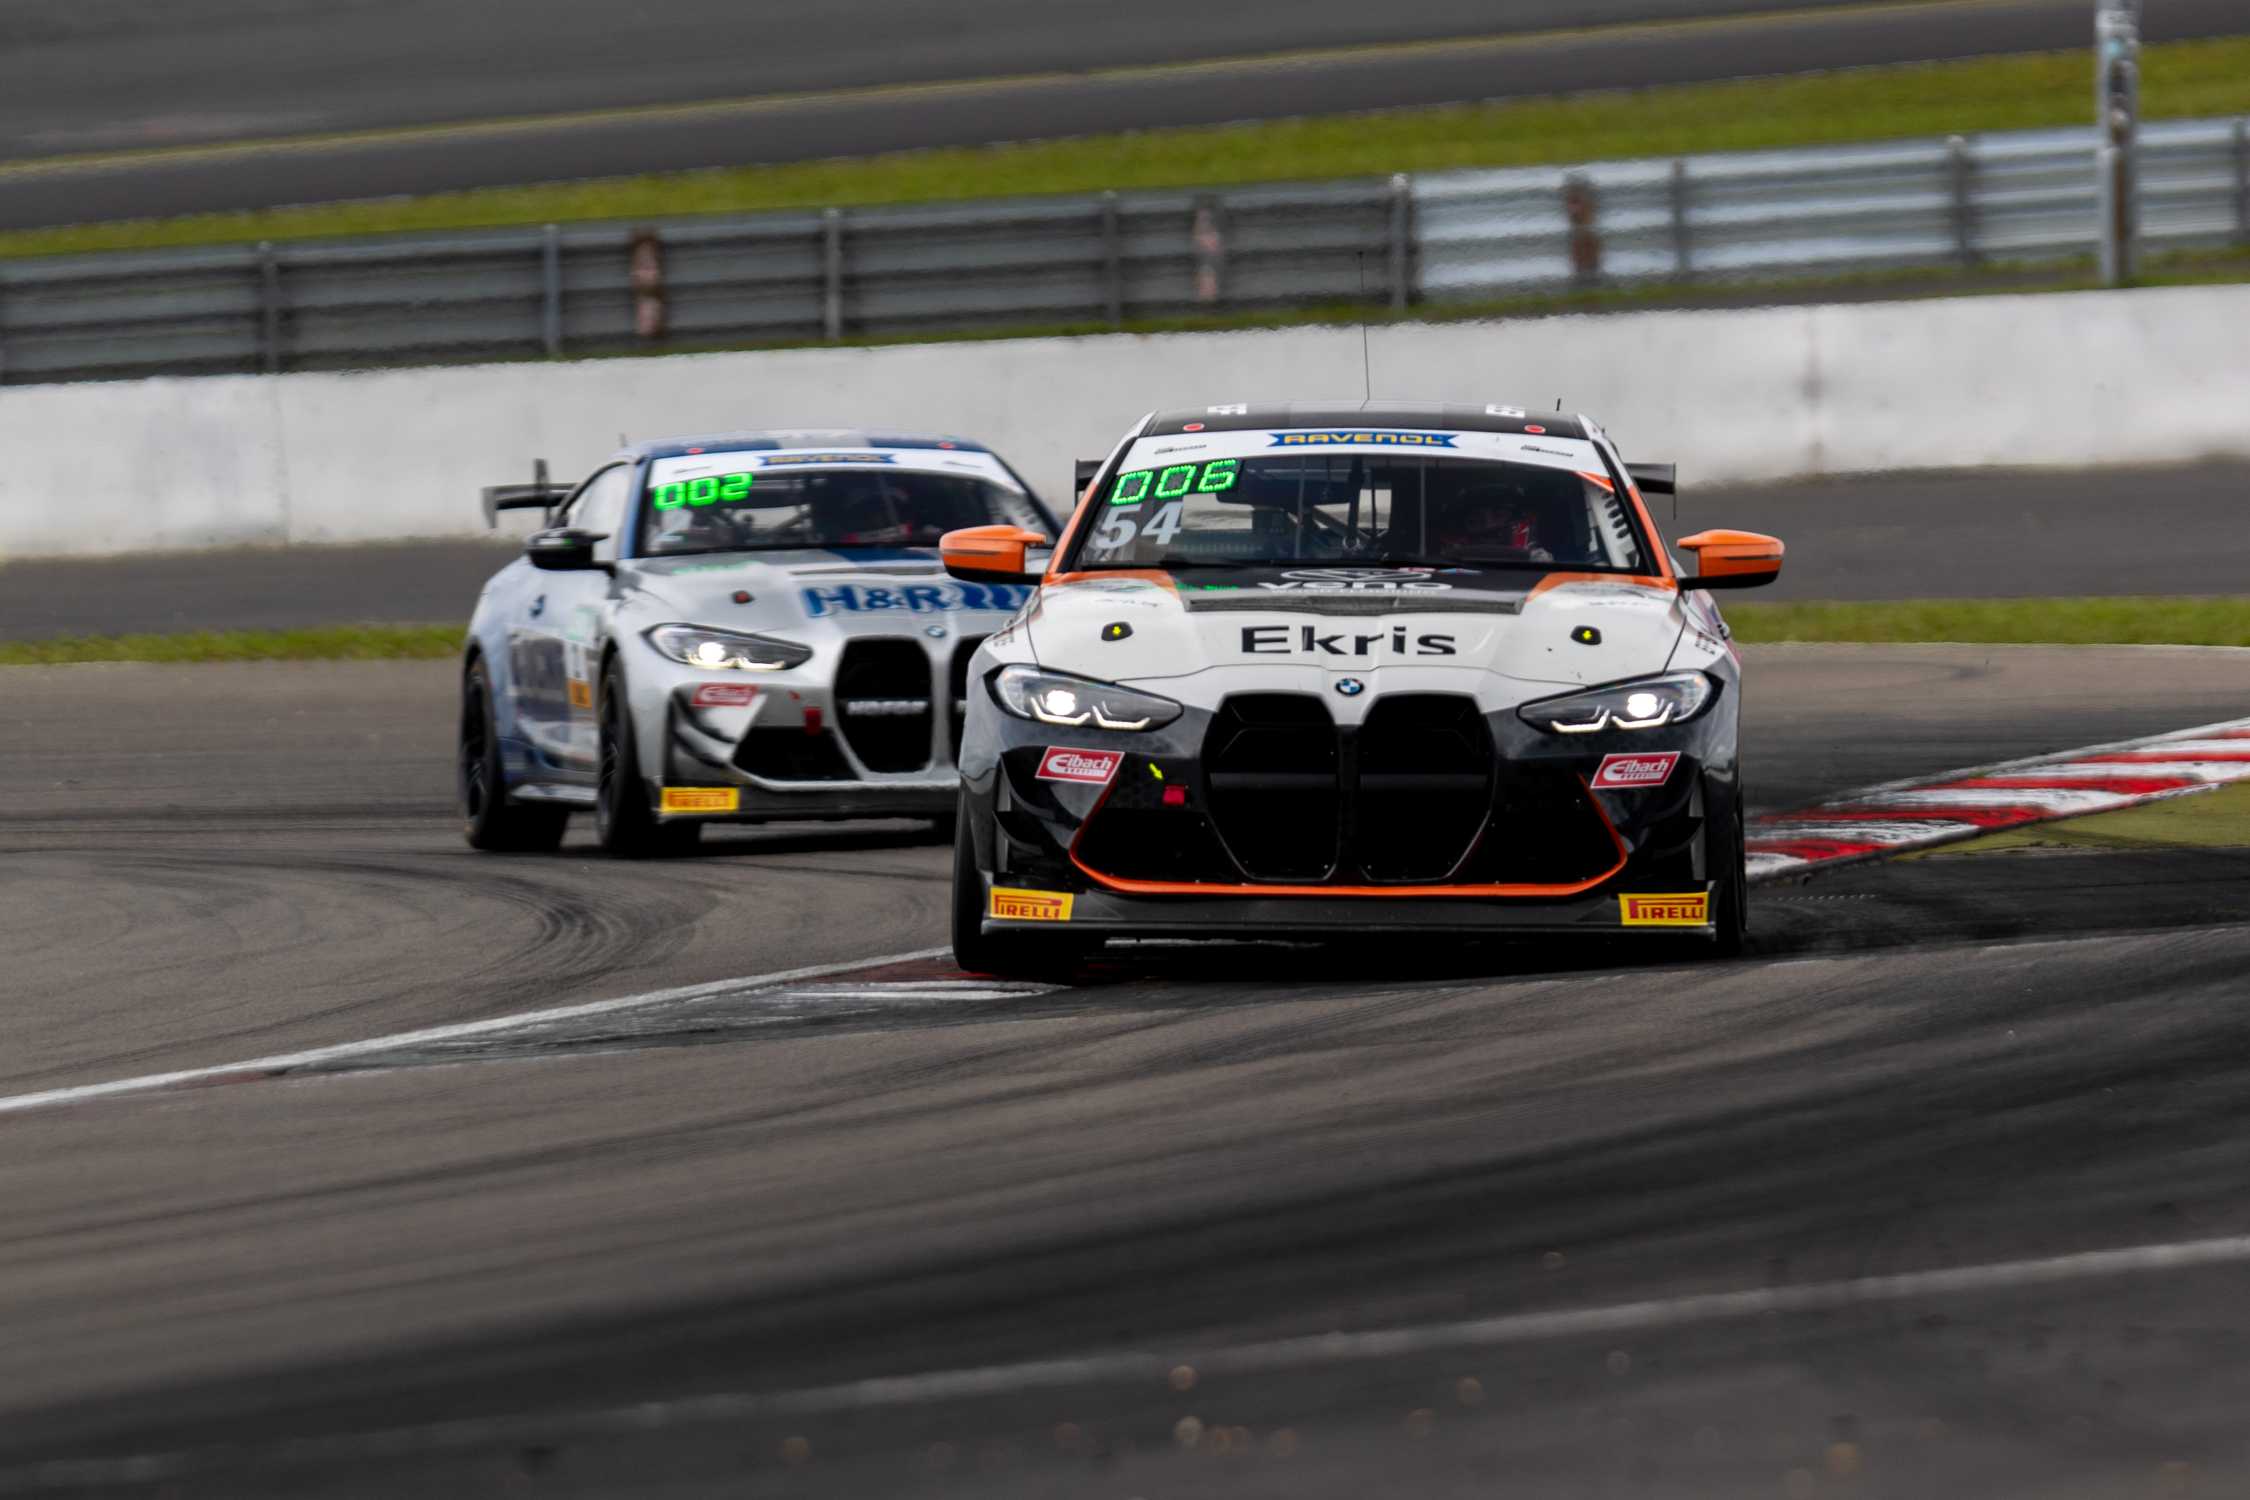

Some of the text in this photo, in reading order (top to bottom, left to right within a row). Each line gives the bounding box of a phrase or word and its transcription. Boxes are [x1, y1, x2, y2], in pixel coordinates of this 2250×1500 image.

[1284, 434, 1443, 444] RAVENOL
[654, 472, 752, 511] 002
[1112, 460, 1237, 504] 006
[1094, 502, 1184, 549] 54
[1241, 626, 1457, 656] Ekris
[1047, 753, 1112, 775] Eibach
[1603, 759, 1669, 781] Eibach
[994, 895, 1063, 918] PIRELLI
[1627, 898, 1704, 919] PIRELLI
